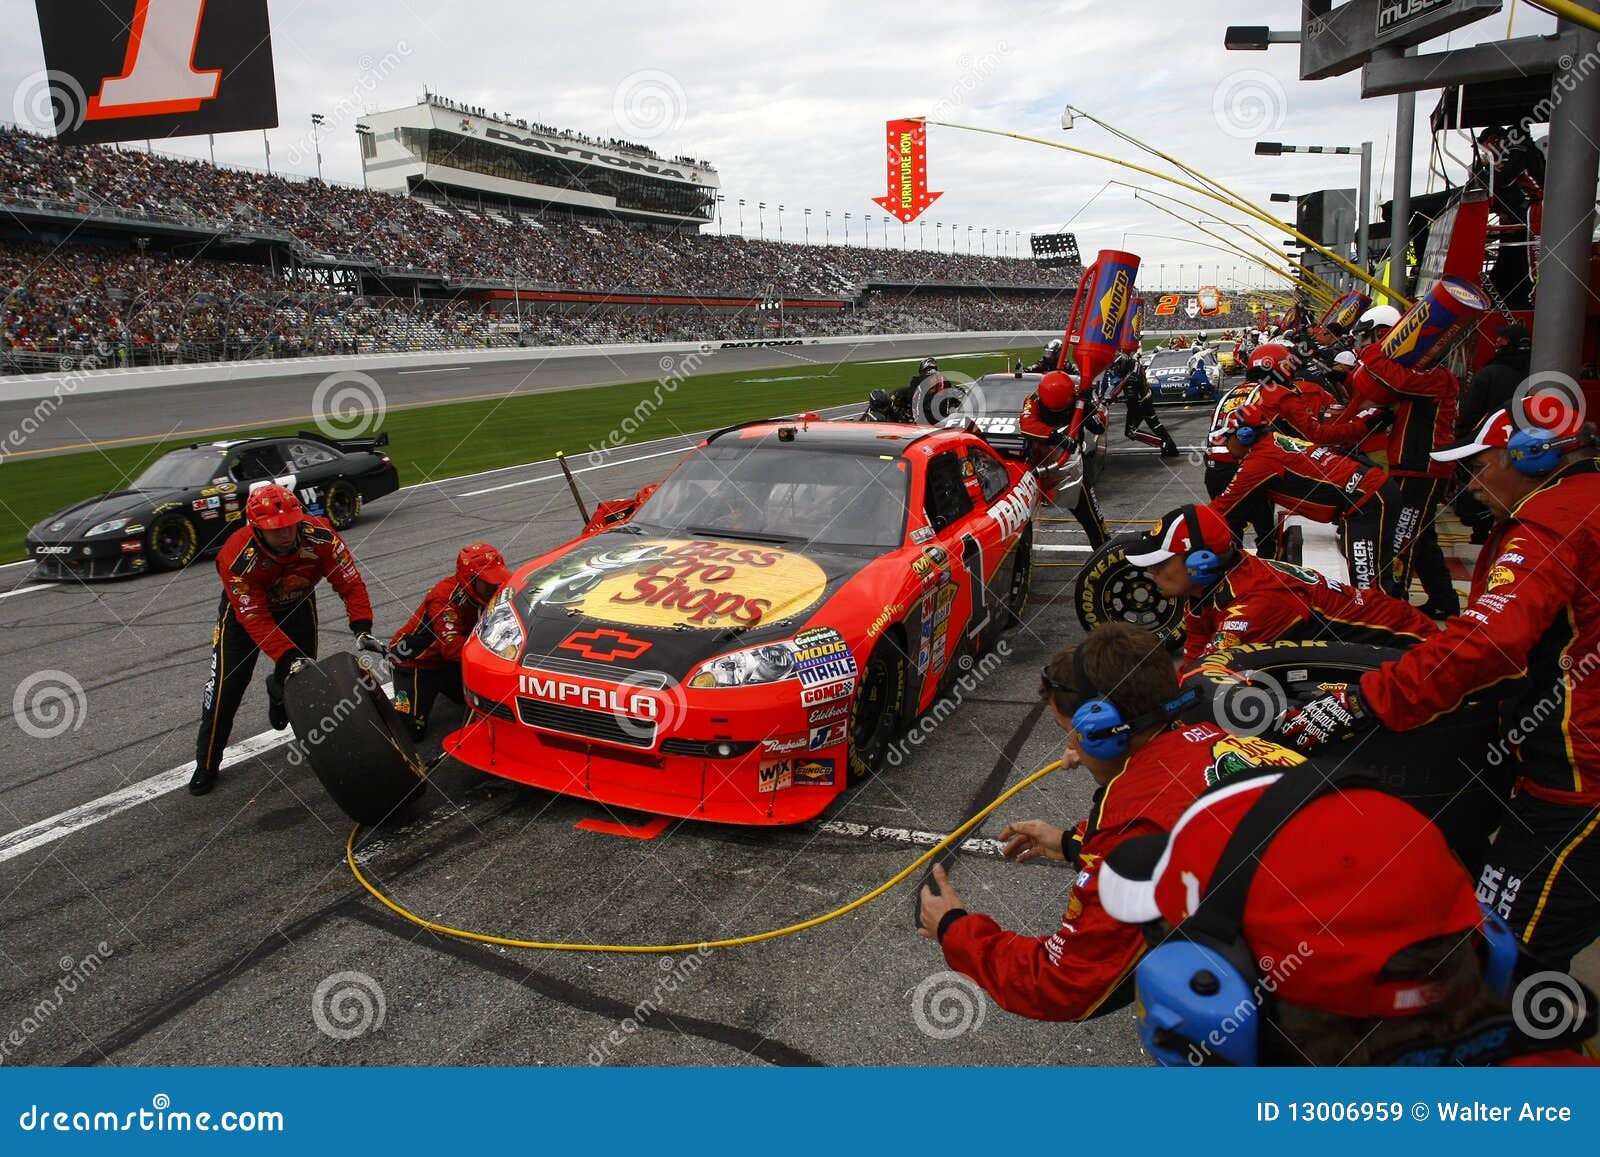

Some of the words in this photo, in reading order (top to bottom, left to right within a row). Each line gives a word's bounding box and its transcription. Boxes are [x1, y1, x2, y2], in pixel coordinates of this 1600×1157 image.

[486, 128, 685, 179] DAYTONA
[901, 133, 912, 153] ROW
[902, 155, 913, 208] FURNITURE
[1102, 270, 1128, 340] SUNOCO
[1154, 294, 1180, 316] 2
[721, 340, 803, 349] DAYTONA
[1383, 304, 1429, 358] UNOCO
[1405, 509, 1420, 539] boats
[36, 546, 72, 555] CAMRY
[661, 540, 785, 568] Bass
[1367, 541, 1375, 576] boats
[638, 556, 736, 584] Pro
[1353, 541, 1370, 590] RACKER
[960, 531, 990, 640] 1
[609, 575, 772, 626] Shops
[795, 629, 838, 645] Gatorback
[795, 641, 848, 663] MOOG
[798, 658, 857, 685] MAHLE
[519, 675, 657, 717] IMPALA
[804, 683, 844, 704] COMP
[809, 703, 849, 723] Edelbrock
[760, 761, 789, 782] WIX
